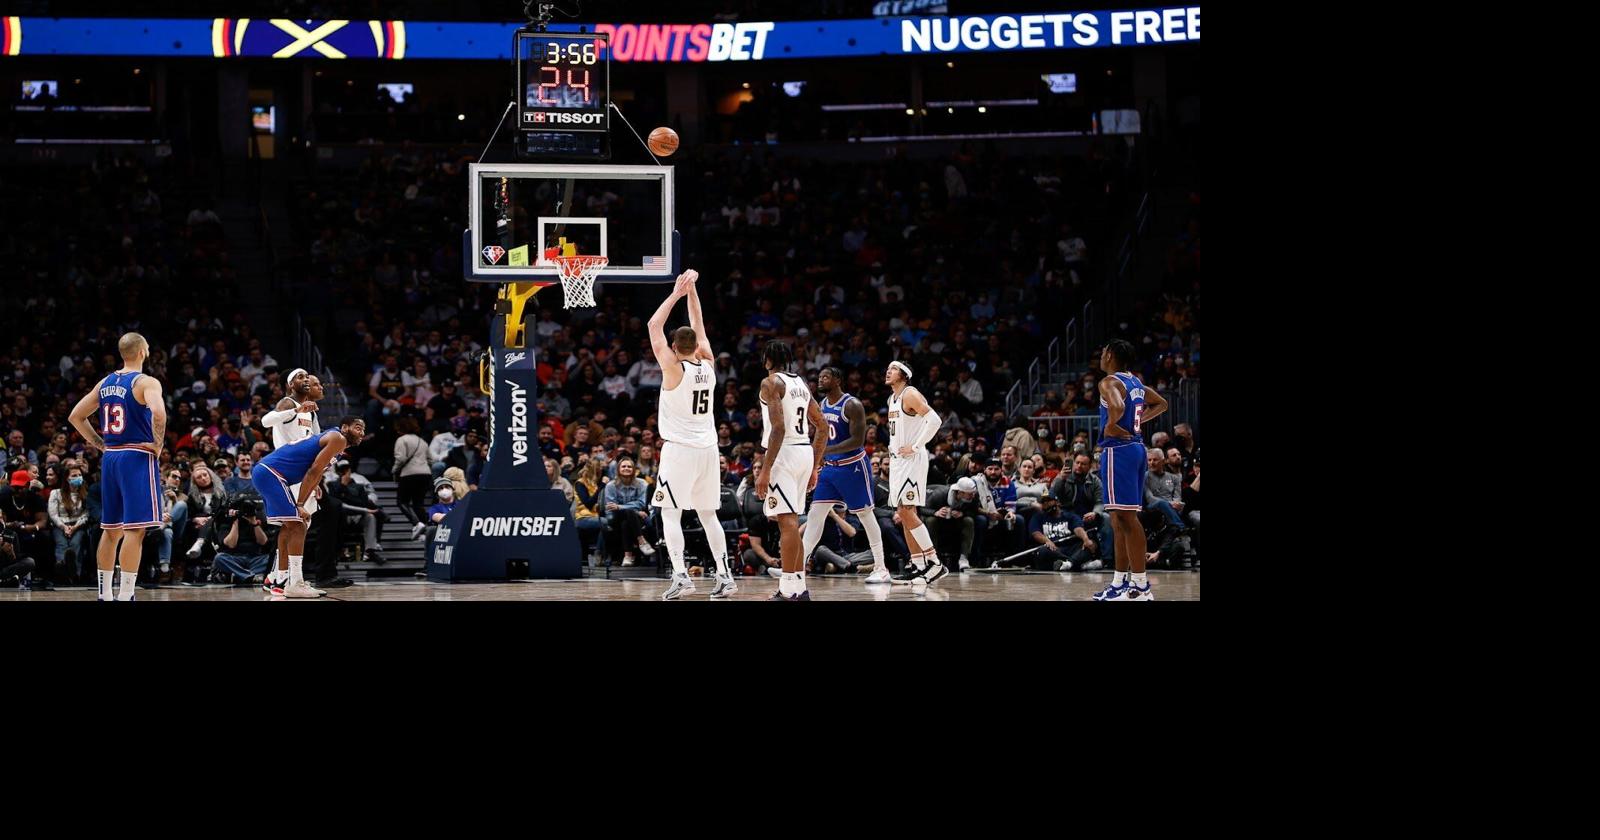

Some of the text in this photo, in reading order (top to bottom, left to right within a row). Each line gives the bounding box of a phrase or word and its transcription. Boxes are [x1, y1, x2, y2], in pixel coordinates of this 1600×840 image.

[901, 12, 1099, 52] NUGGETS
[547, 42, 596, 65] 3:56
[539, 66, 590, 103] 24
[546, 112, 604, 124] TISSOT
[692, 389, 709, 415] 15
[103, 403, 126, 434] 13
[508, 389, 528, 466] verizon
[795, 406, 805, 435] 3
[469, 516, 565, 537] POINTSBET
